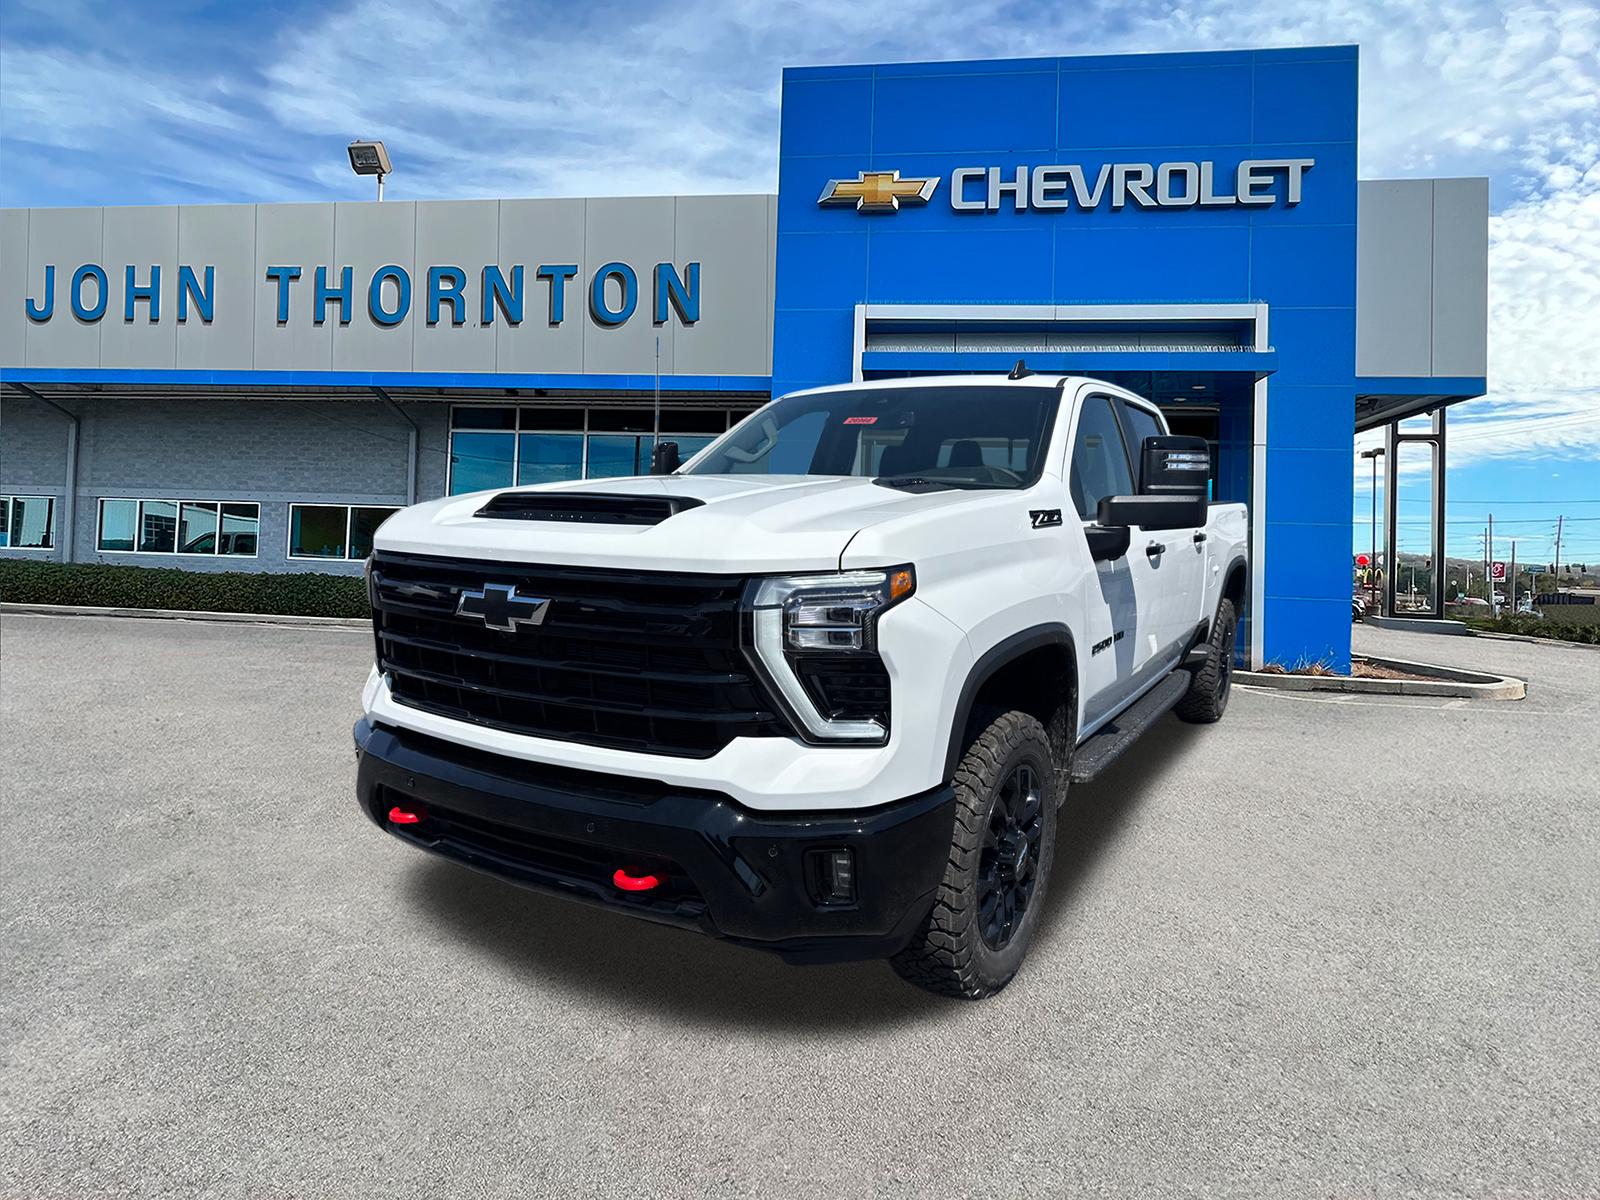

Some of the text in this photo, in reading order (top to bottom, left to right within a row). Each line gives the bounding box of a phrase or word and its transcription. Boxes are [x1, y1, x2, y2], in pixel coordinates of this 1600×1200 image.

[951, 158, 1315, 211] CHEVROLET
[25, 262, 701, 328] JOHN THORNTON
